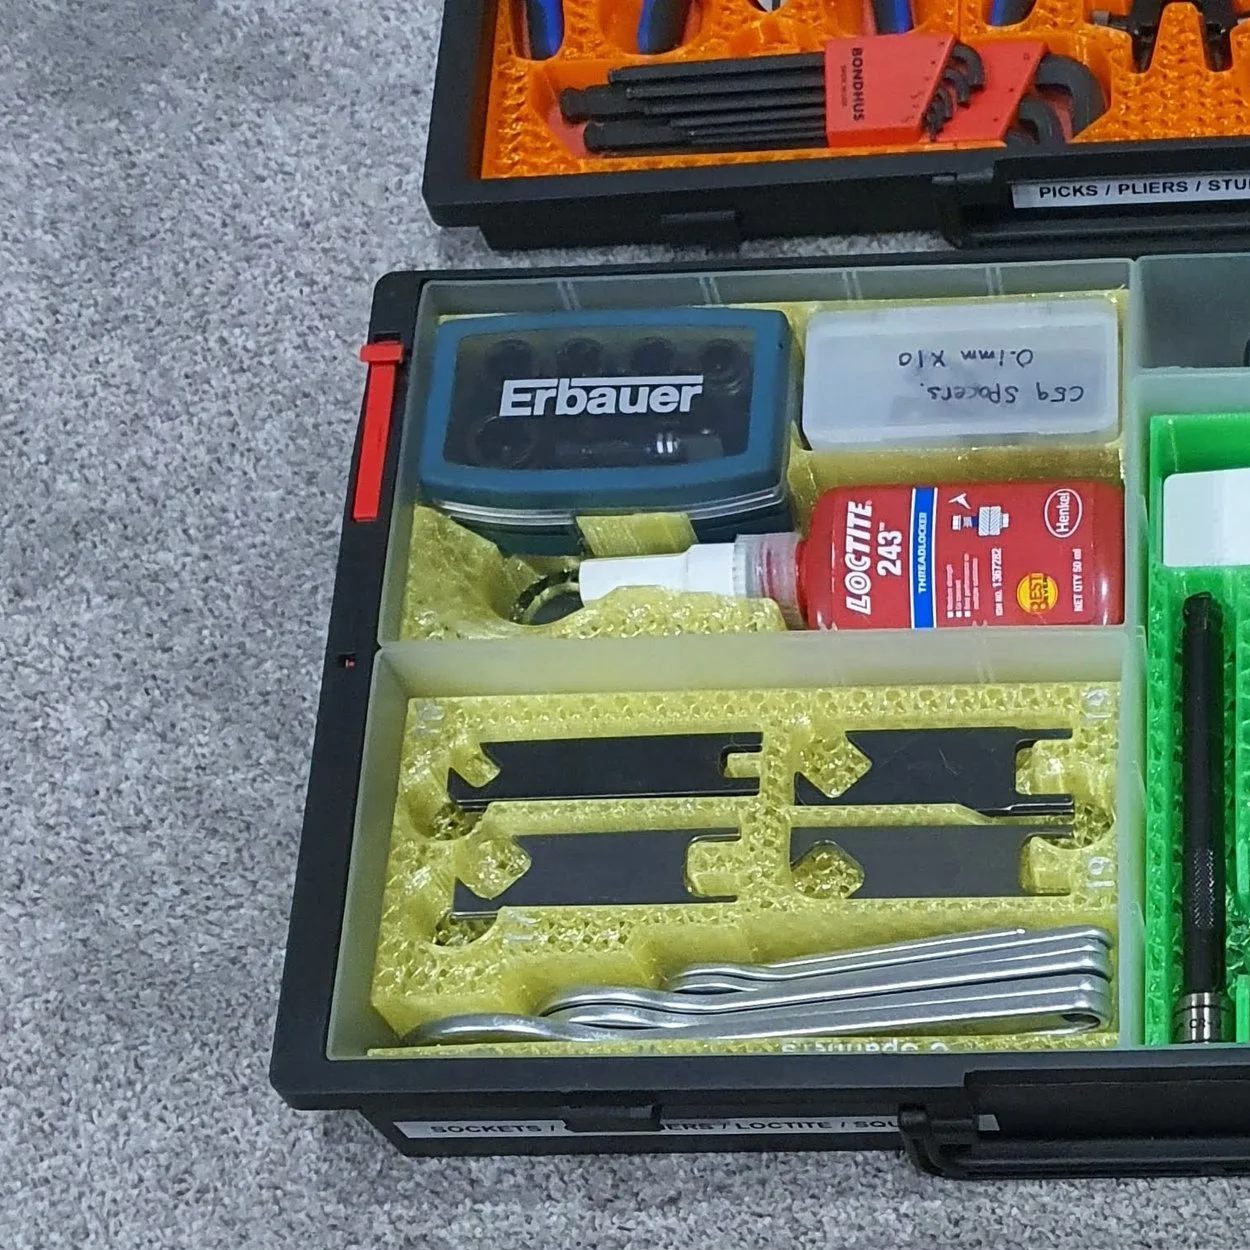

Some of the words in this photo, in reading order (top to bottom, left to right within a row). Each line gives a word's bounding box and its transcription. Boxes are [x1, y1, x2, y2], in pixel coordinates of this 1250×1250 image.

[852, 48, 865, 121] BONDHUS
[1039, 184, 1098, 199] PICKS
[1118, 180, 1188, 196] PLIERS
[499, 375, 704, 418] Erbauer
[1055, 492, 1071, 533] Henkel
[844, 500, 873, 616] LOCTITE
[917, 512, 928, 594] THREADLOCKER
[1029, 573, 1049, 613] BEST
[430, 1124, 541, 1134] SOCKETS
[734, 1120, 834, 1131] LOCTITE
